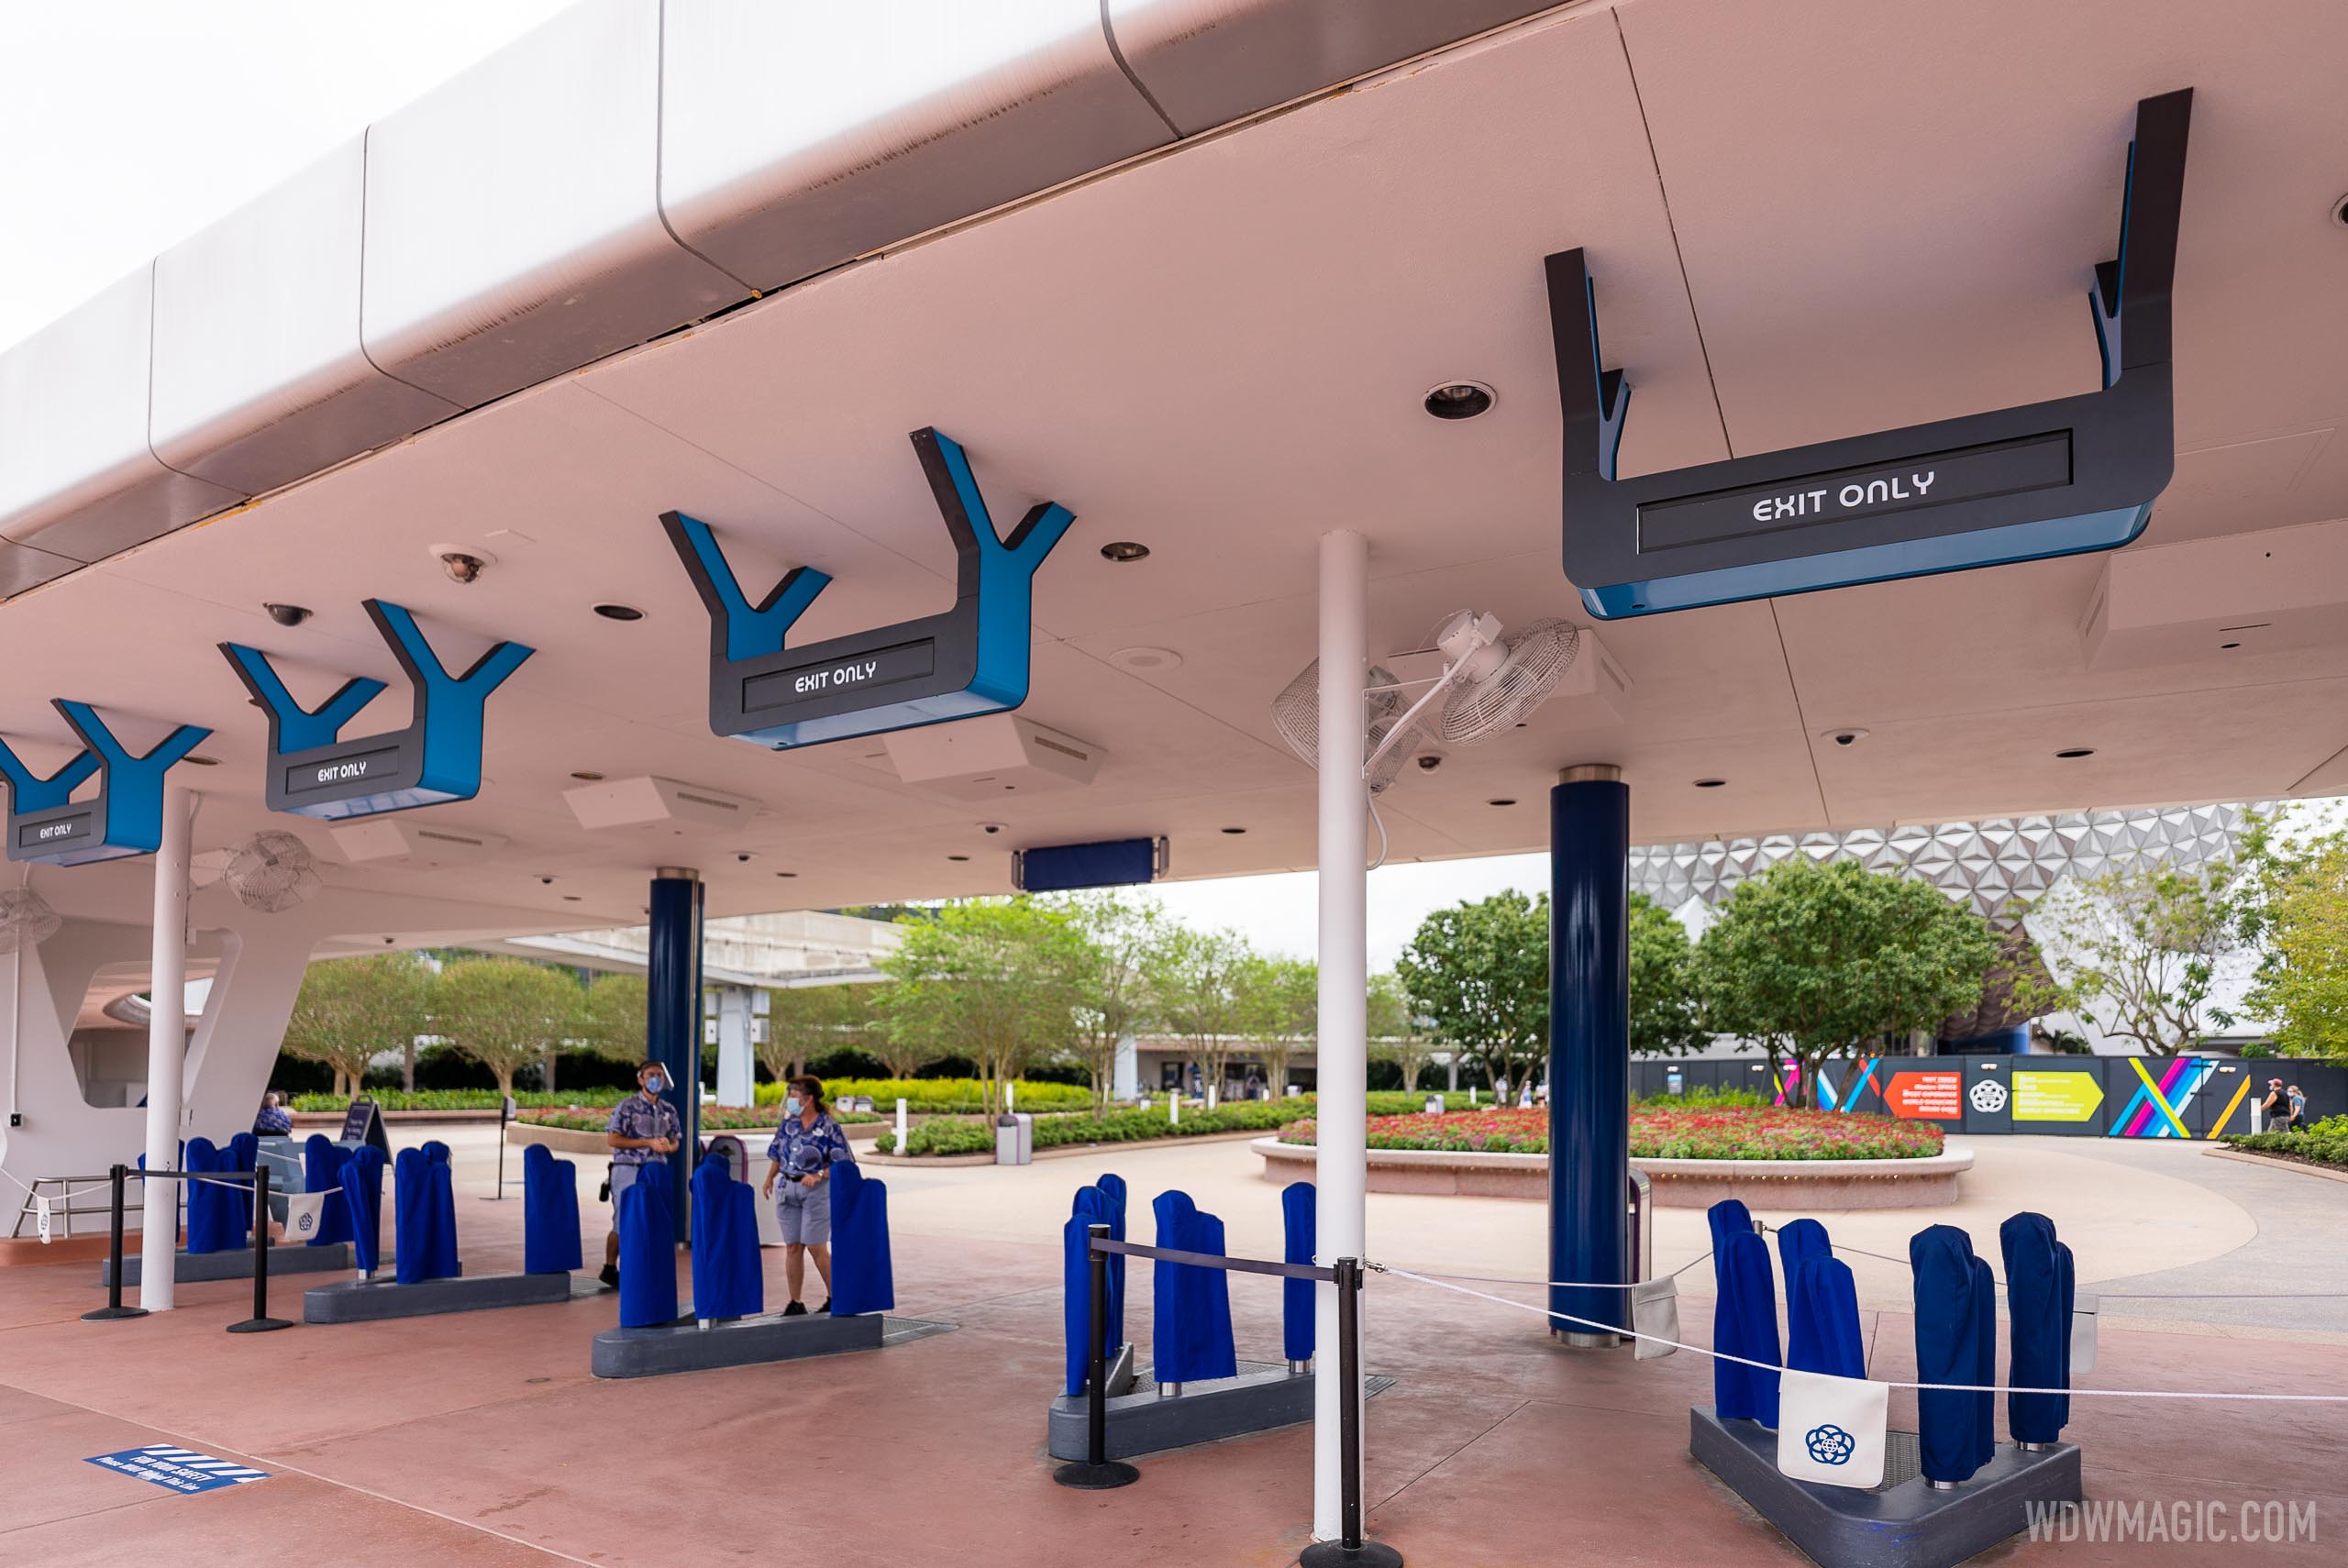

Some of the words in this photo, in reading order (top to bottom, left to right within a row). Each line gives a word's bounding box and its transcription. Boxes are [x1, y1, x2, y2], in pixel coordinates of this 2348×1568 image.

[1753, 490, 1827, 522] EXIT
[1839, 471, 1934, 507] ONLY
[795, 671, 829, 692] EXIT
[833, 661, 876, 685] ONLY
[317, 766, 339, 782] EXIT
[340, 761, 367, 778] ONLY
[39, 826, 54, 839] EXIT
[54, 823, 72, 836] ONLY
[171, 1468, 216, 1482] SAFETY
